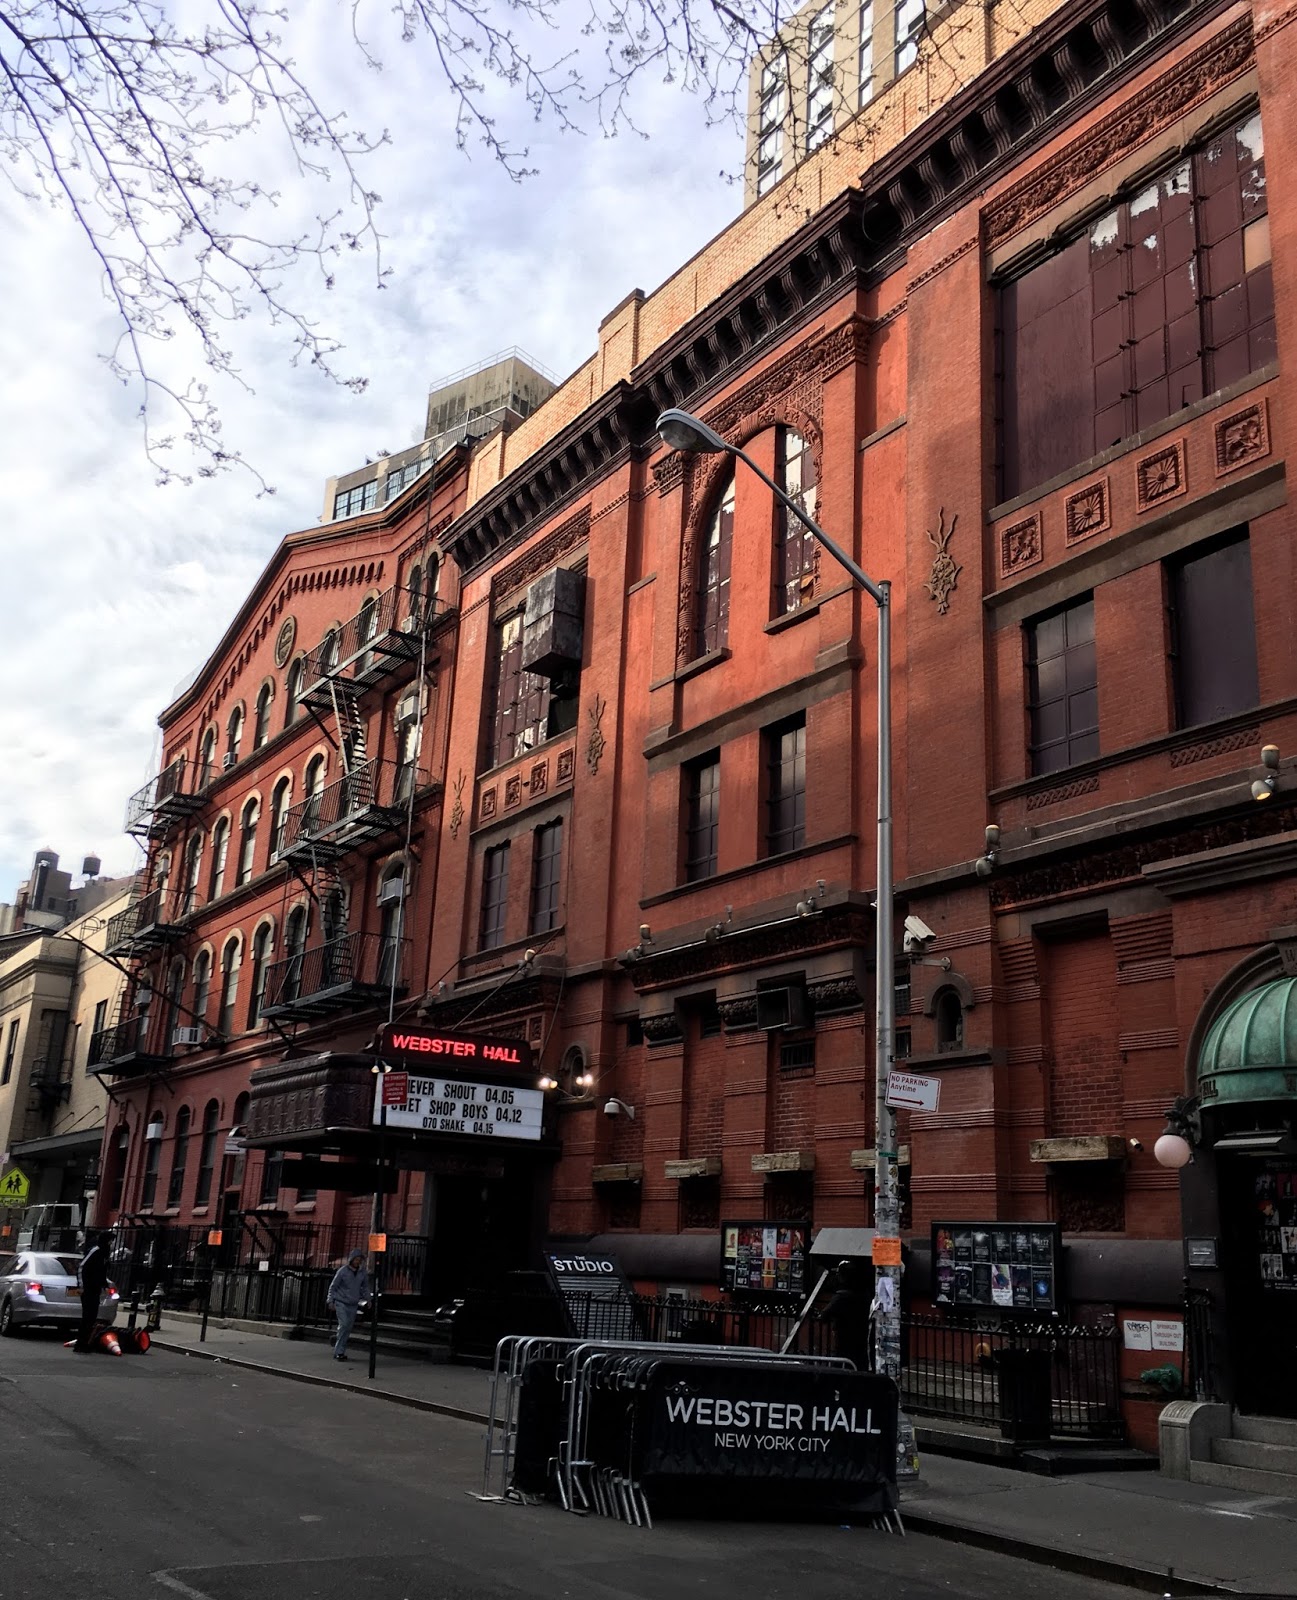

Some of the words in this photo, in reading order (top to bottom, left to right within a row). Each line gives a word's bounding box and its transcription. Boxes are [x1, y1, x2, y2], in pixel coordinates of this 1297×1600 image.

[392, 1034, 476, 1057] WEBSTER
[483, 1045, 521, 1063] HALL
[890, 1082, 917, 1093] Anytime
[891, 1075, 900, 1083] NO
[901, 1077, 929, 1087] PARKING
[443, 1083, 477, 1101] SHOUT
[485, 1087, 515, 1104] 04.05
[429, 1099, 456, 1116] SHOP
[462, 1103, 488, 1120] BOYS
[495, 1107, 522, 1123] 04.12
[422, 1117, 437, 1130] 070
[440, 1119, 465, 1132] SHAKE
[473, 1122, 494, 1134] 04.15
[553, 1260, 614, 1272] STUDIO
[665, 1395, 804, 1431] WEBSTER
[811, 1405, 882, 1434] HALL
[714, 1432, 751, 1449] NEW
[754, 1434, 795, 1451] YORK
[798, 1436, 831, 1453] CITY
